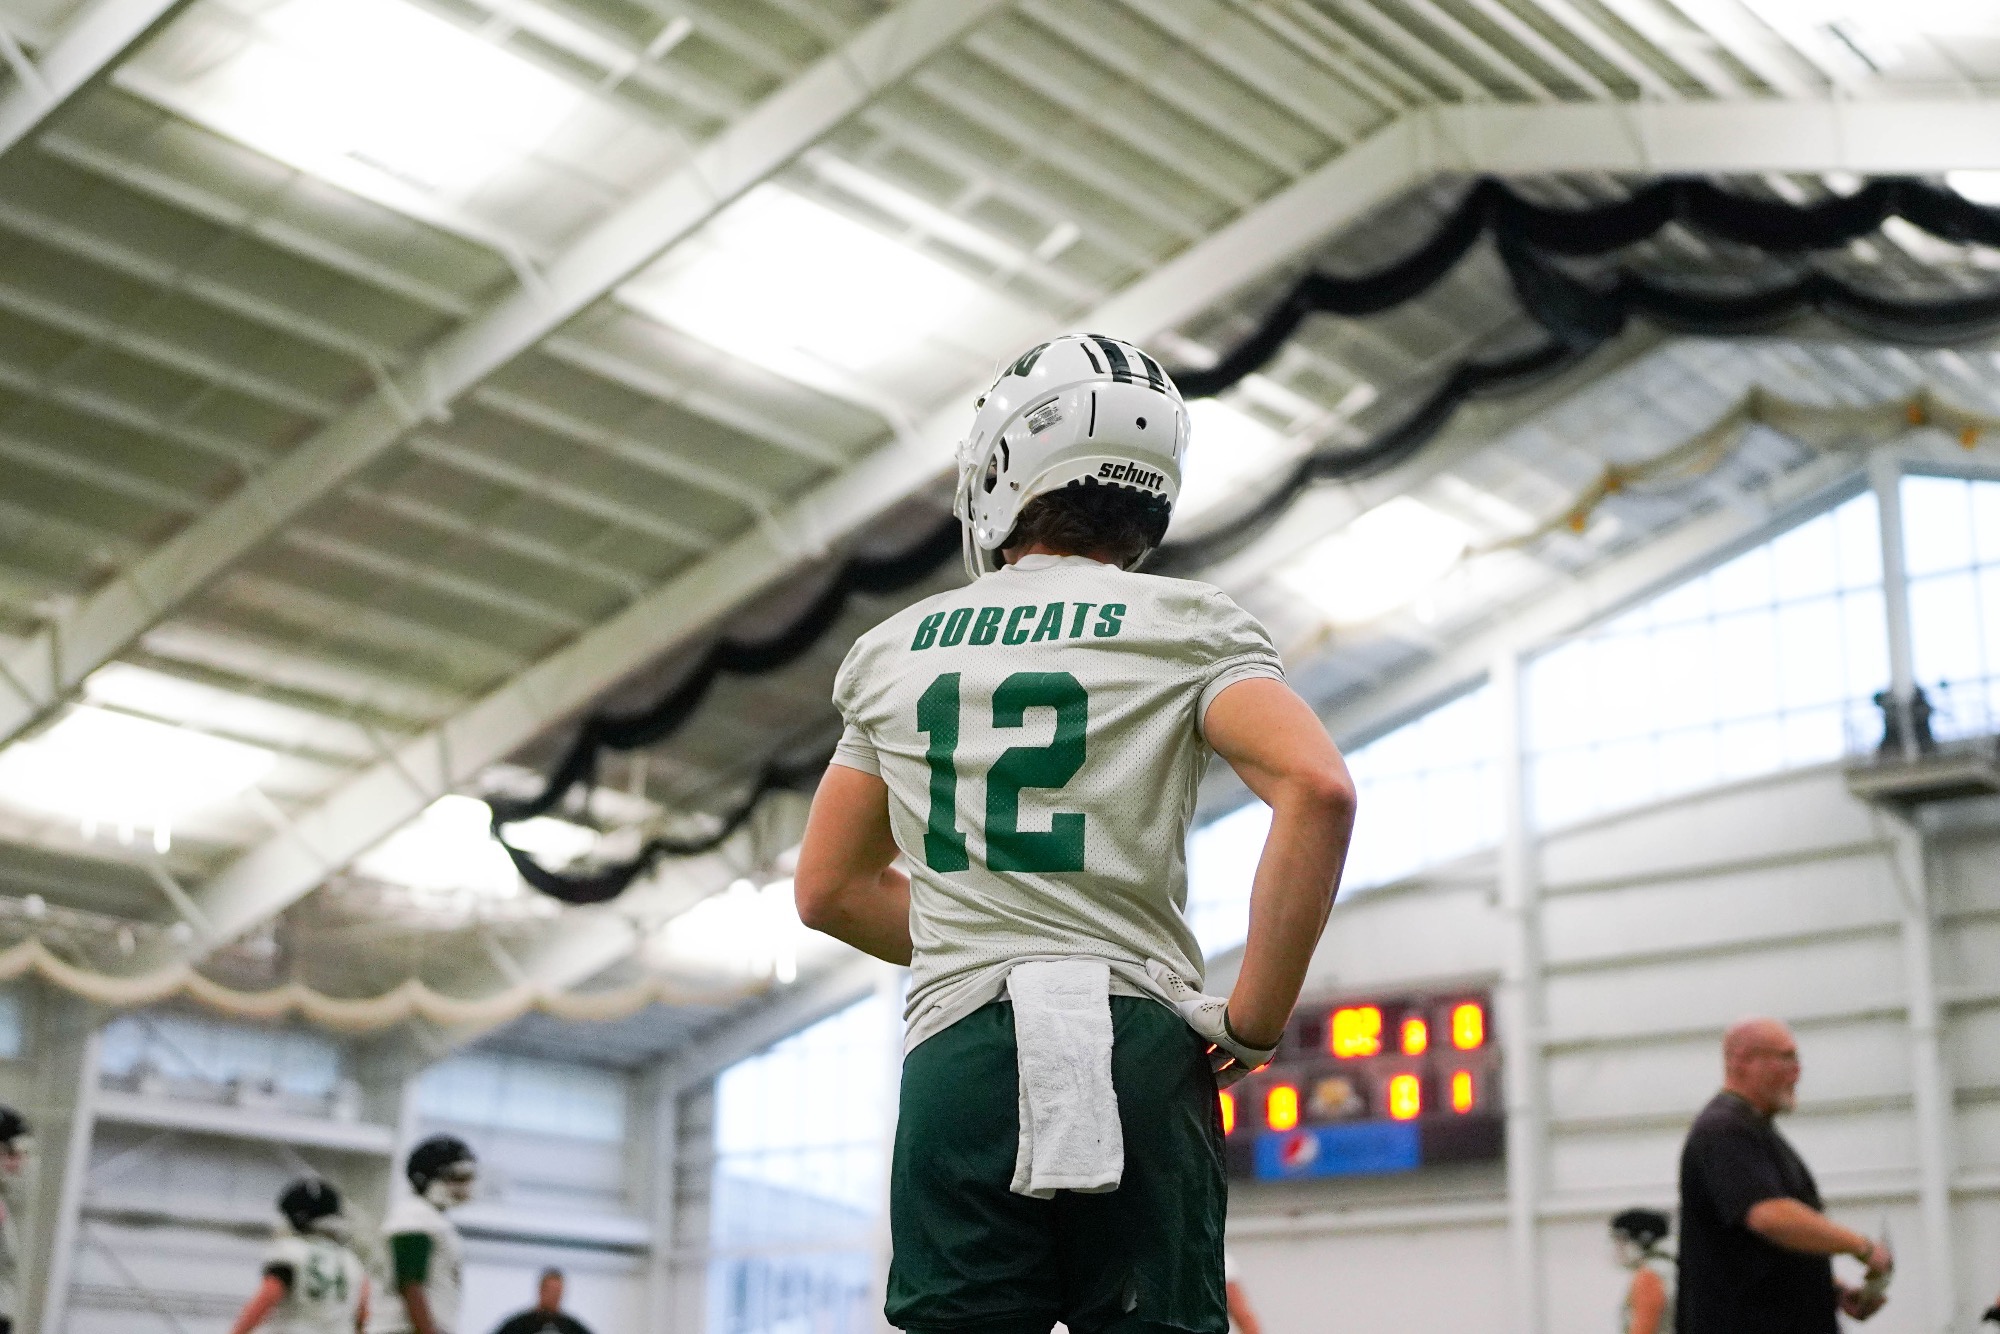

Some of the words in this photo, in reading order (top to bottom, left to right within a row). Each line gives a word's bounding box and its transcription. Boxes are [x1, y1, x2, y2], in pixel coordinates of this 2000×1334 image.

[1097, 461, 1164, 491] schutt
[910, 601, 1127, 652] BOBCATS
[916, 671, 1089, 874] 12
